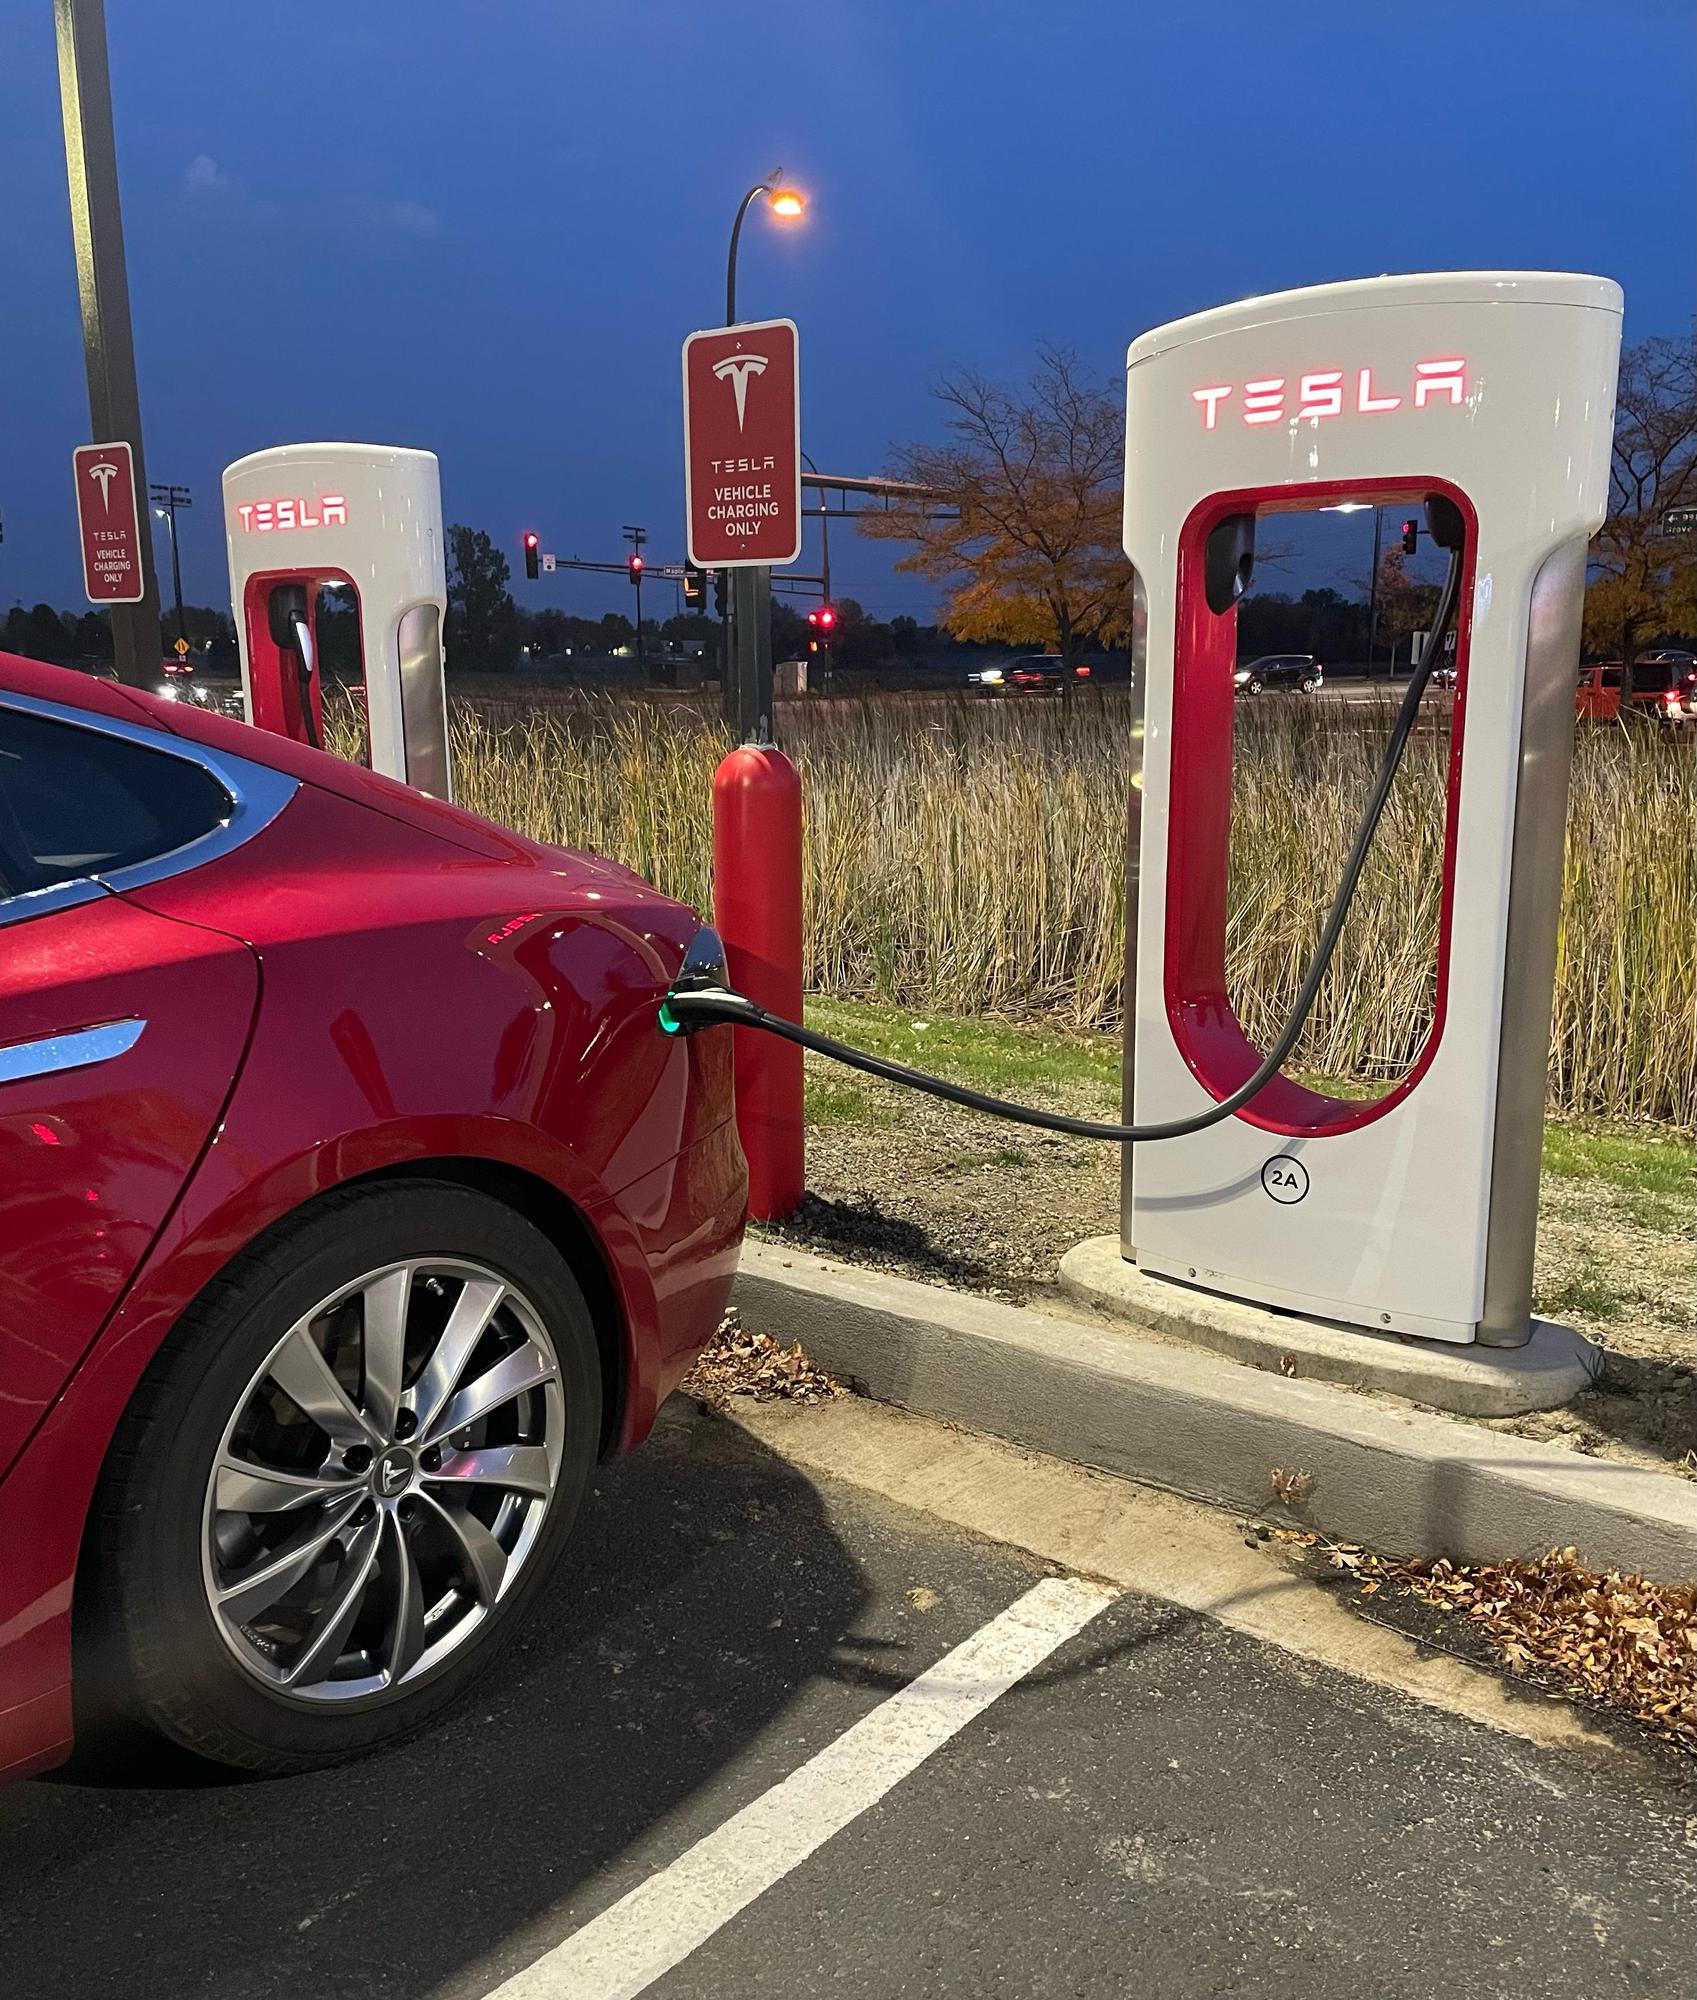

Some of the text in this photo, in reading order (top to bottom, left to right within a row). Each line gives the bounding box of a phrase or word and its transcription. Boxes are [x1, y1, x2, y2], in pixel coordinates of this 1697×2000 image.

[1191, 359, 1466, 430] TESLA
[711, 456, 774, 474] TESLA
[714, 484, 771, 501] VEHICLE
[238, 496, 346, 533] TESLA
[707, 501, 779, 520] CHARGING
[93, 530, 127, 541] TESLA
[725, 521, 761, 537] ONLY
[96, 548, 126, 560] VEHICLE
[93, 560, 131, 572] CHARGING
[103, 573, 123, 583] ONLY
[1271, 1170, 1299, 1190] 2A
